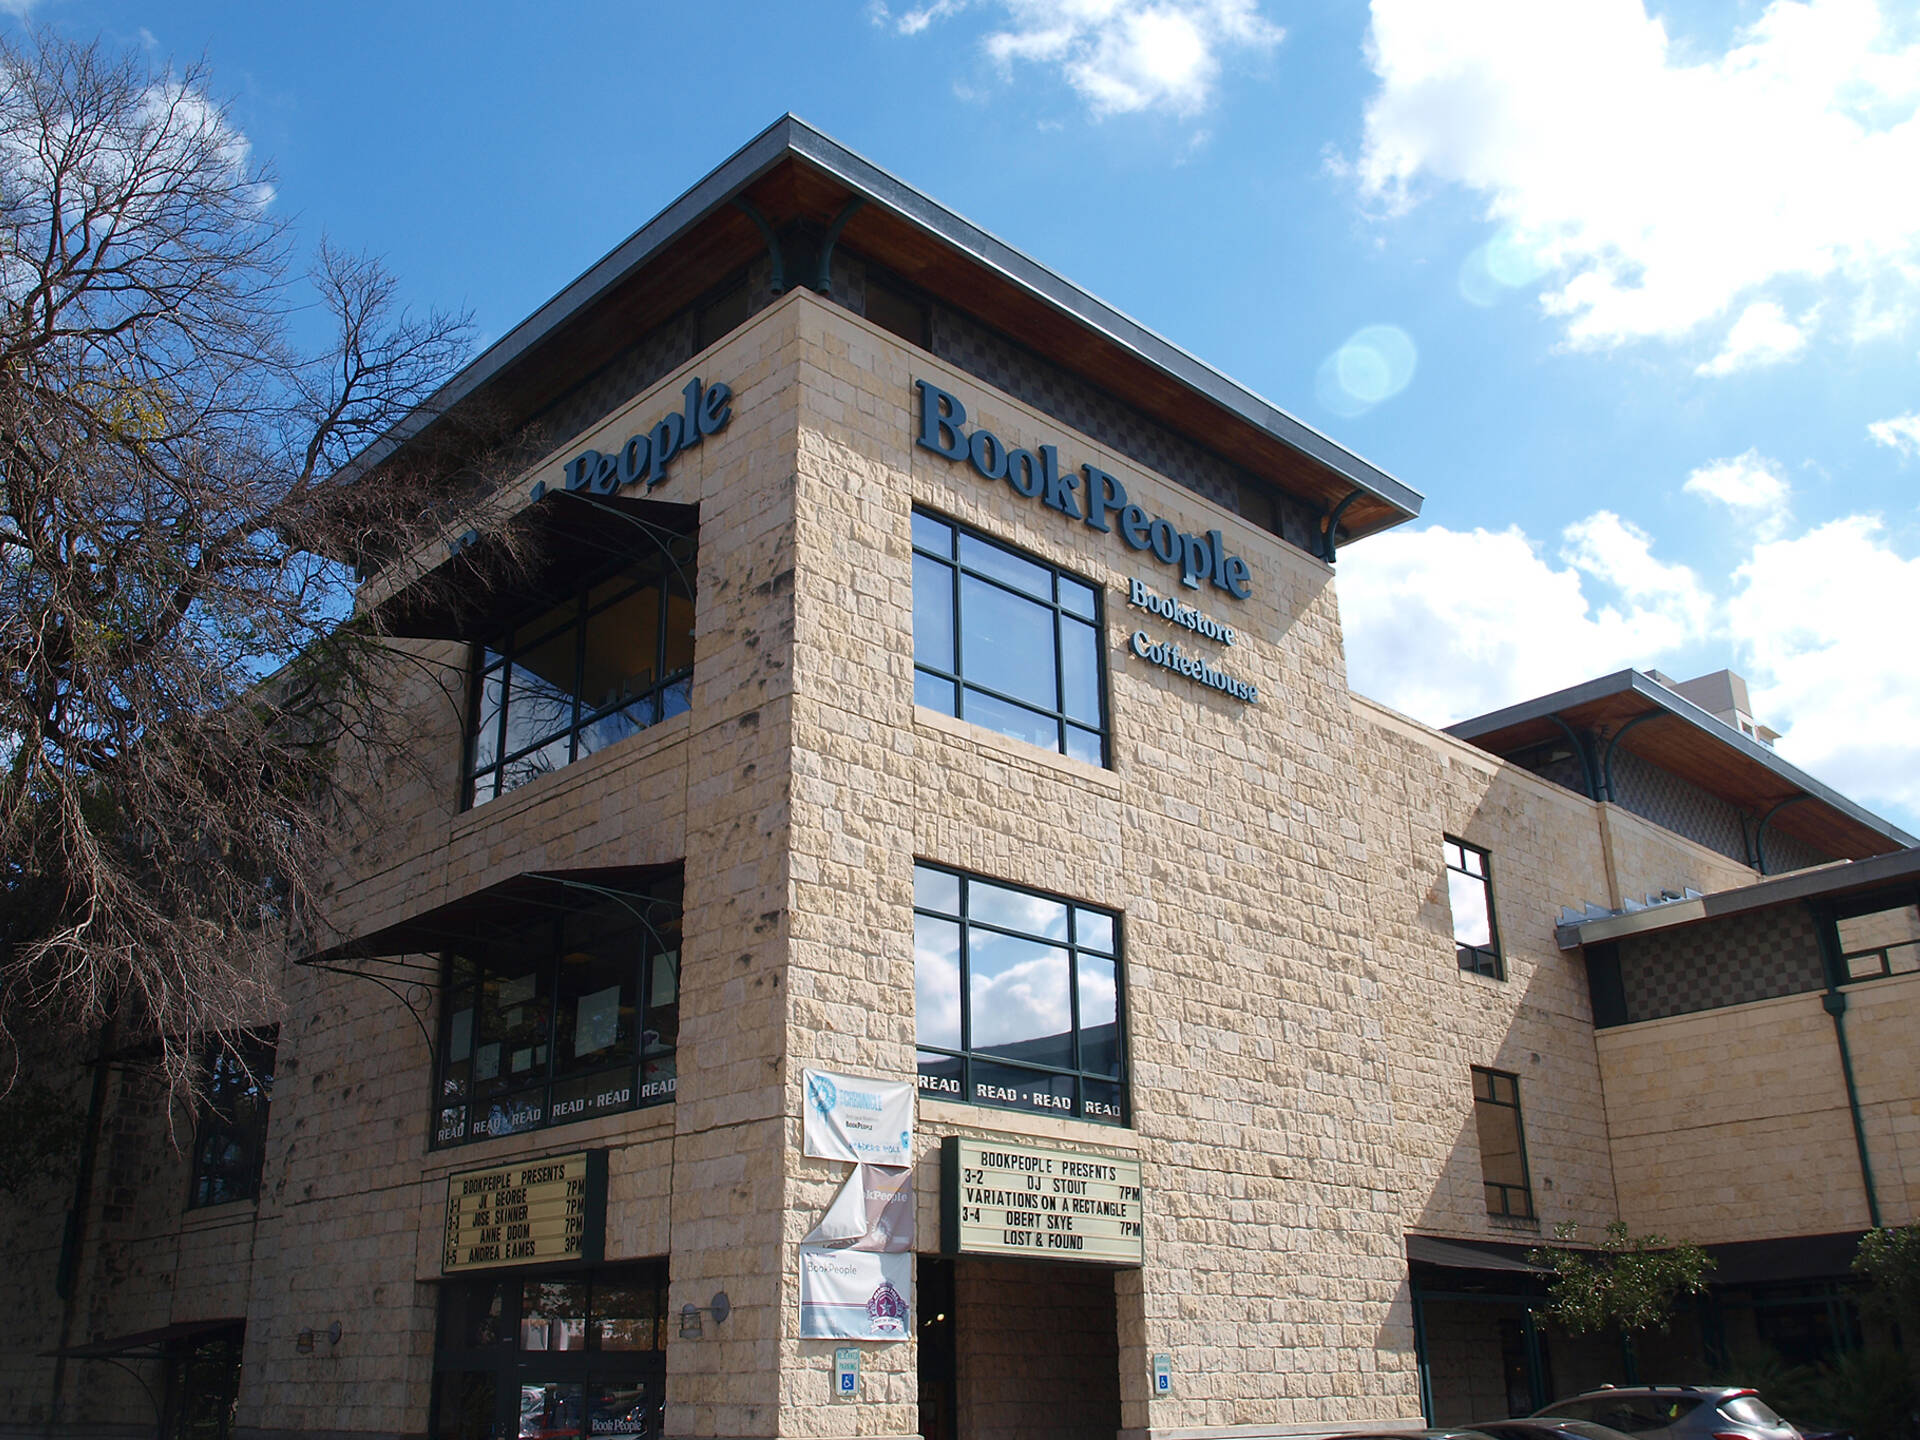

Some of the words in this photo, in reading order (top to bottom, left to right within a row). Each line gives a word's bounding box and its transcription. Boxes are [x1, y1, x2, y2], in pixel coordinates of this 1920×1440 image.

[1128, 576, 1236, 647] Bookstore
[1129, 629, 1259, 704] Coffeehouse
[438, 1126, 464, 1141] READ
[473, 1119, 501, 1135] READ
[512, 1109, 541, 1126] READ
[553, 1099, 584, 1117] READ
[597, 1088, 630, 1107] READ
[642, 1078, 676, 1098] READ
[918, 1074, 961, 1093] READ
[977, 1084, 1017, 1101] READ
[1033, 1092, 1071, 1111] READ
[1085, 1100, 1121, 1117] READ
[463, 1173, 511, 1195] BOOKPEOPLE
[521, 1164, 565, 1185] PRESENTS
[981, 1151, 1052, 1173] BOOKPEOPLE
[1062, 1161, 1116, 1181] PRESENTS
[495, 1188, 527, 1207] GEORGE
[566, 1180, 585, 1197] 7PM
[964, 1168, 983, 1185] 3-2
[1053, 1178, 1087, 1195] STOUT
[1119, 1185, 1140, 1201] 7PM
[472, 1210, 490, 1227] JOSE
[495, 1205, 528, 1224] SKINNER
[566, 1198, 584, 1215] 7PM
[967, 1187, 1038, 1208] VARIATIONS
[1041, 1195, 1056, 1211] ON
[1062, 1198, 1069, 1212] A
[1073, 1198, 1127, 1217] RECTANGLE
[480, 1227, 501, 1243] ANNE
[507, 1223, 530, 1240] ODOM
[565, 1217, 583, 1234] 7PM
[962, 1206, 980, 1223] 3-4
[1006, 1211, 1041, 1228] OBERT
[1047, 1214, 1073, 1230] SKYE
[1120, 1221, 1141, 1237] 7PM
[468, 1244, 500, 1263] ANDREA
[505, 1240, 535, 1259] EAMES
[565, 1236, 582, 1252] 3PM
[1003, 1230, 1033, 1246] LOST
[1036, 1232, 1043, 1247] &
[1049, 1233, 1083, 1250] FOUND
